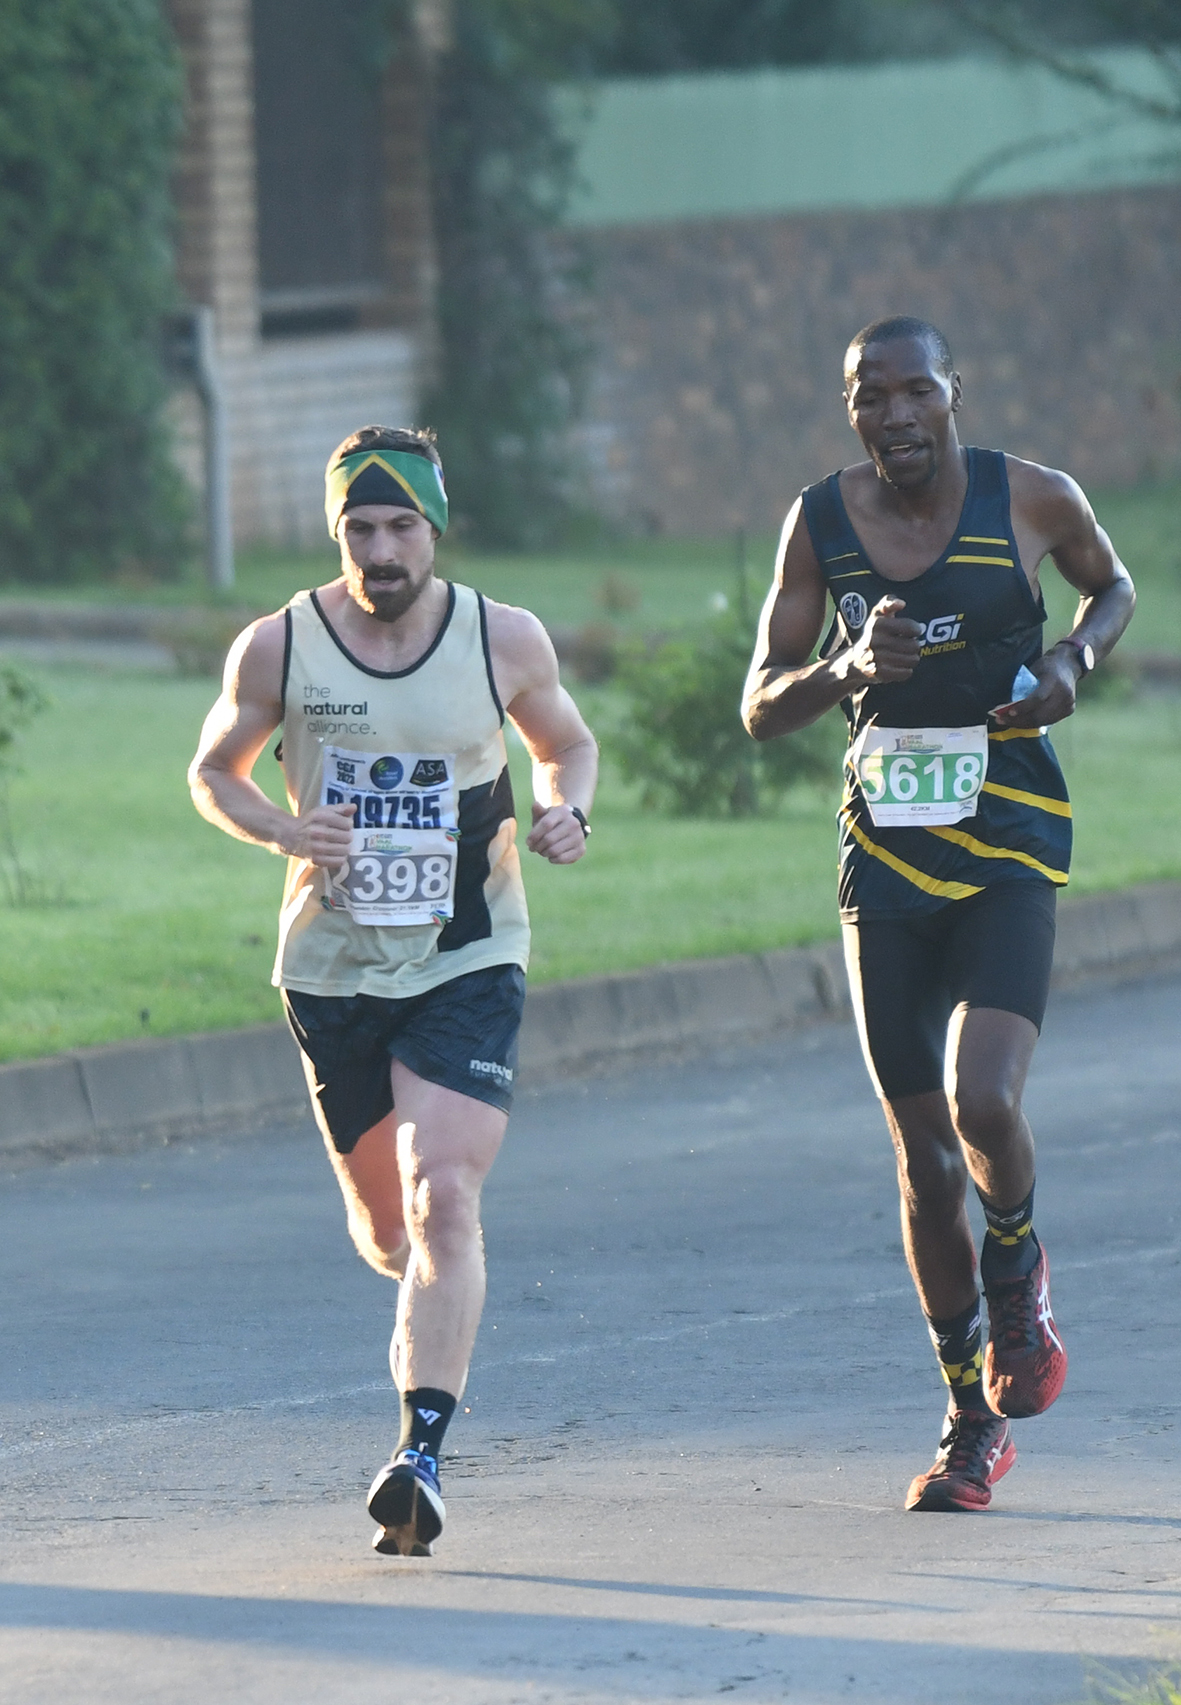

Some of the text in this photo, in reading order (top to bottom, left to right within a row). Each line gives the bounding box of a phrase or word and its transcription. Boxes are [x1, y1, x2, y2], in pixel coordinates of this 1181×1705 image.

[920, 641, 966, 657] Nutrition
[303, 684, 331, 698] the
[303, 701, 368, 715] natural
[307, 720, 377, 735] alliance.
[416, 762, 446, 776] ASA
[861, 755, 981, 802] 5618
[350, 794, 442, 829] 19735
